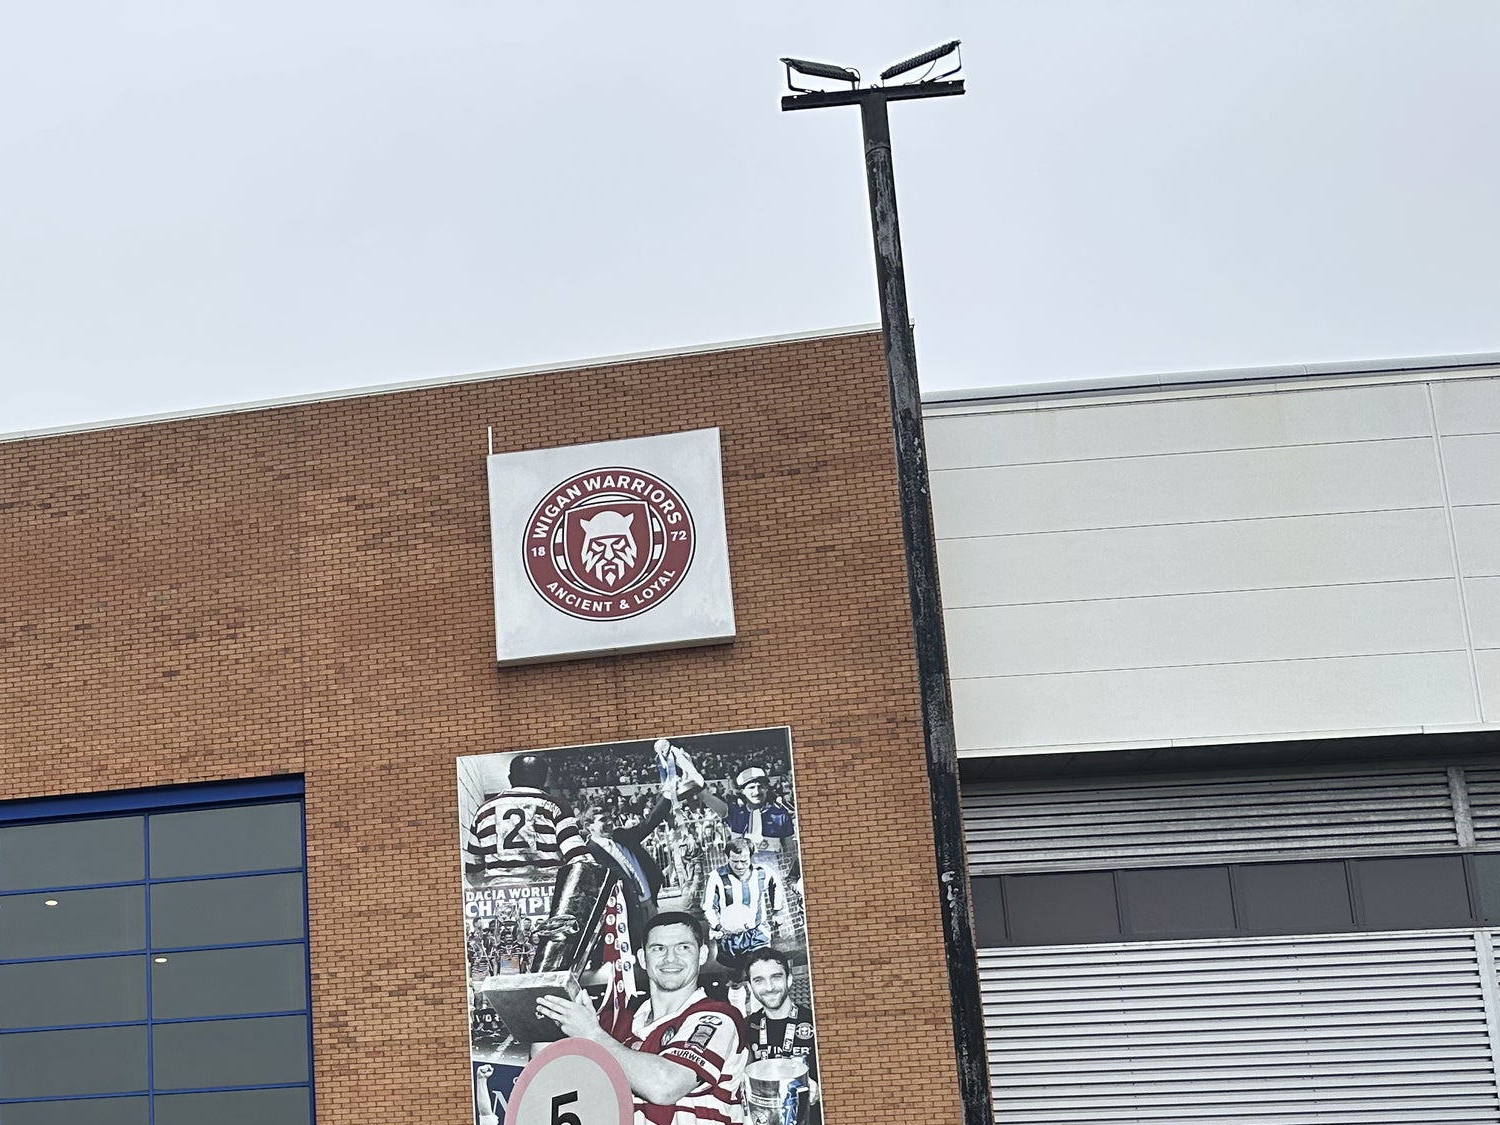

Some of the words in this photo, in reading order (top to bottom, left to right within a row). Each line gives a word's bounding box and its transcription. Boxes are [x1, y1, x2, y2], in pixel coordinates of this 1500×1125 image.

[533, 484, 582, 539] WIGAN
[583, 474, 682, 525] WARRIORS
[671, 530, 687, 542] 72
[531, 547, 546, 557] 18
[547, 581, 612, 612] ANCIENT
[619, 599, 630, 611] &
[634, 569, 676, 605] LOYAL
[503, 808, 530, 849] 2
[466, 889, 506, 901] DACIA
